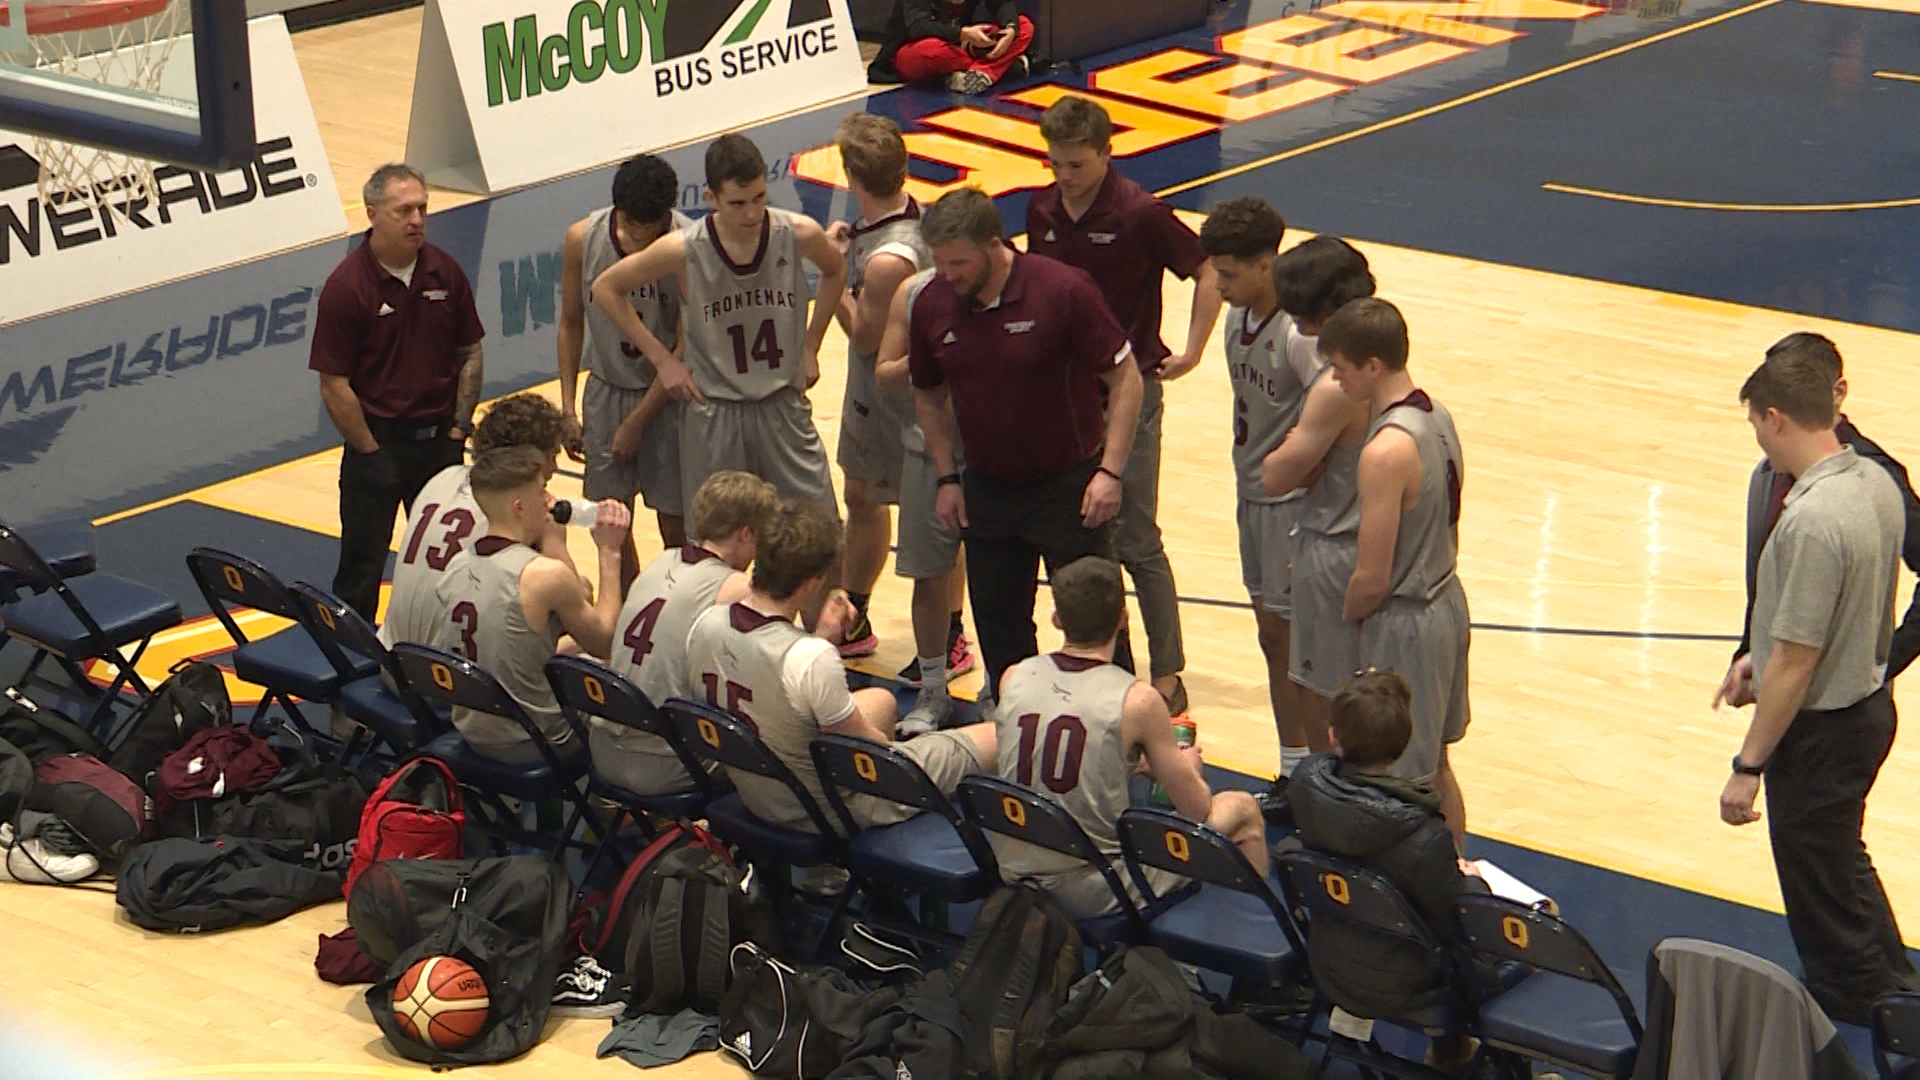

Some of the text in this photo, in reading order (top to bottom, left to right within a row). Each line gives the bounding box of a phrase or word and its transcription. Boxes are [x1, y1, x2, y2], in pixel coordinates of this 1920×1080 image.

[655, 24, 838, 97] BUS SERVICE
[703, 289, 796, 323] FRONTENAC
[727, 318, 784, 375] 14
[403, 502, 476, 572] 13
[223, 565, 244, 593] Q
[451, 600, 479, 663] 3
[623, 597, 668, 666] 4
[431, 662, 454, 690] Q
[584, 675, 605, 704] Q
[702, 672, 760, 736] 15
[697, 718, 720, 749] Q
[854, 752, 878, 783] Q
[1016, 713, 1088, 794] 10
[1002, 796, 1026, 827] Q
[1165, 830, 1190, 862] Q
[1324, 872, 1351, 906] Q
[1502, 915, 1530, 950] Q
